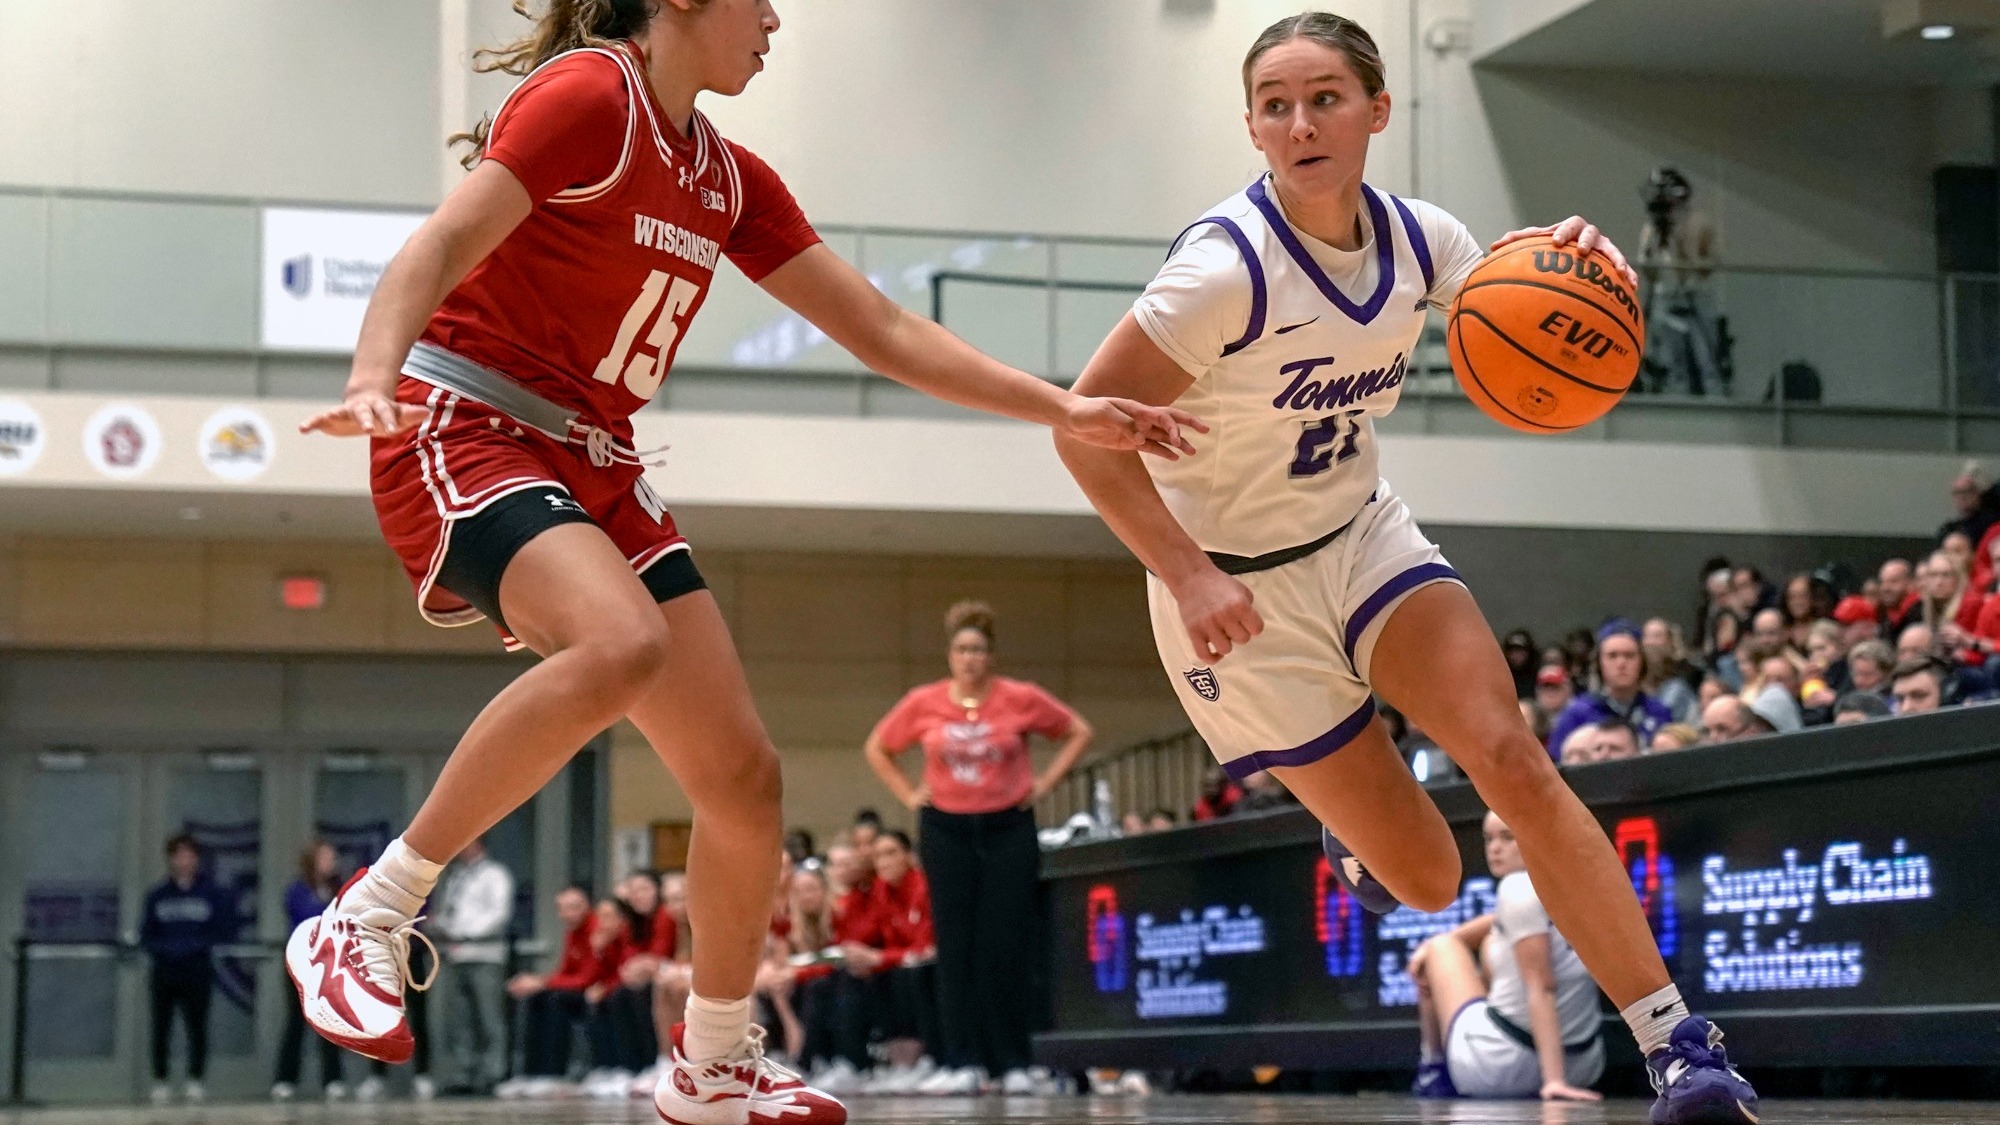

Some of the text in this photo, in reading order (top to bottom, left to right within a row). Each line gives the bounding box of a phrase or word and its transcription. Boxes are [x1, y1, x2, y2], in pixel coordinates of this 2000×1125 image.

[634, 213, 720, 272] WISCONSIN
[1532, 250, 1640, 326] Wilson
[592, 268, 701, 400] 15
[1538, 311, 1614, 359] EVO
[1703, 838, 1932, 922] Supply Chain
[1704, 928, 1864, 993] Solutions
